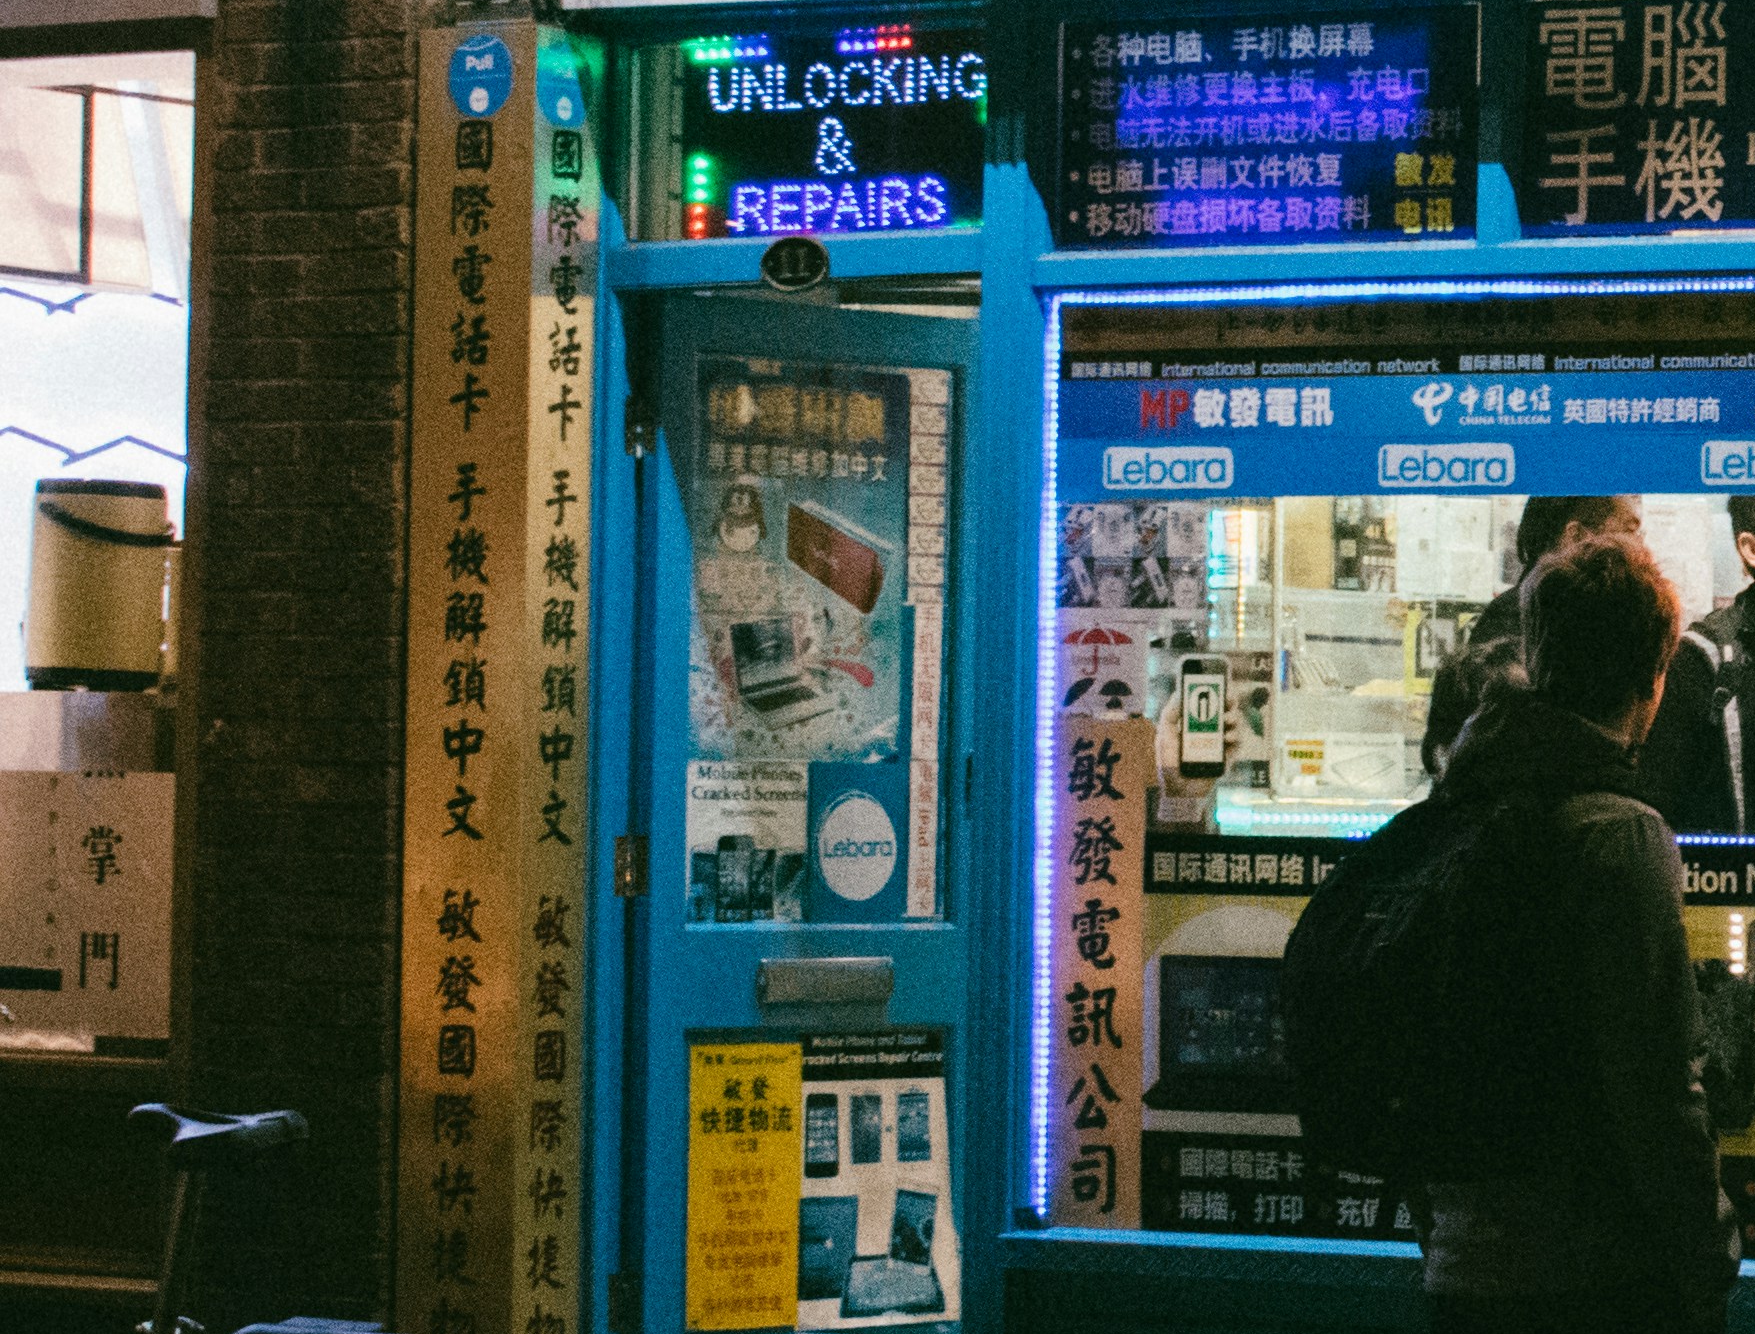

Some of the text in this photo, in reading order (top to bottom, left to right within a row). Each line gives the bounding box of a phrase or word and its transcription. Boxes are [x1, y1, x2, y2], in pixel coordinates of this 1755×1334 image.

[707, 52, 988, 113] UNLOCKING
[1538, 0, 1728, 110] 電腦
[814, 115, 857, 176] &
[1538, 116, 1727, 226] 手機
[733, 175, 948, 232] REPAIRS
[451, 120, 493, 433] 國際電話卡
[546, 129, 584, 443] 國際電話卡
[1139, 386, 1334, 429] MP 敏發電訊
[1106, 453, 1227, 486] Lebara
[1380, 447, 1507, 485] Lebara
[821, 834, 894, 861] Lebara
[1064, 736, 1126, 1215] 敏發電訊公司
